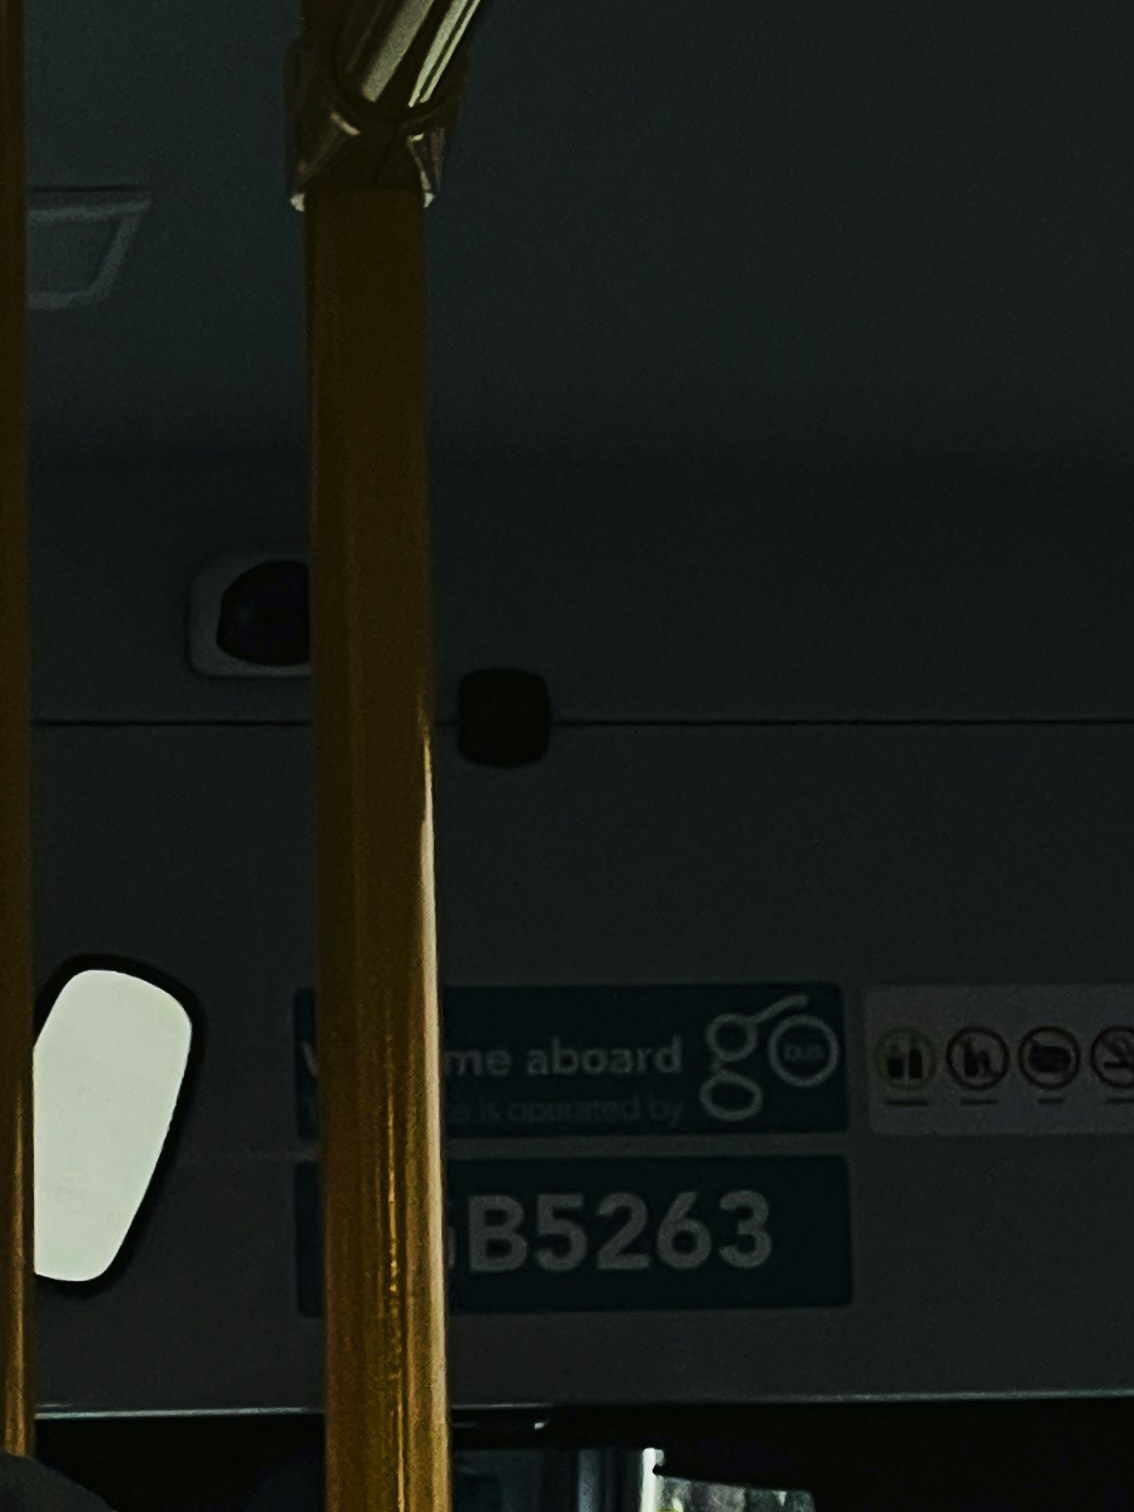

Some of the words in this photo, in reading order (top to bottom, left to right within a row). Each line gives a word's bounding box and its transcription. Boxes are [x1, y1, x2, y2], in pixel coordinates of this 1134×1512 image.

[526, 1035, 682, 1076] aboard
[508, 1092, 640, 1126] operated
[648, 1092, 685, 1128] by
[447, 1190, 773, 1272] B5263
